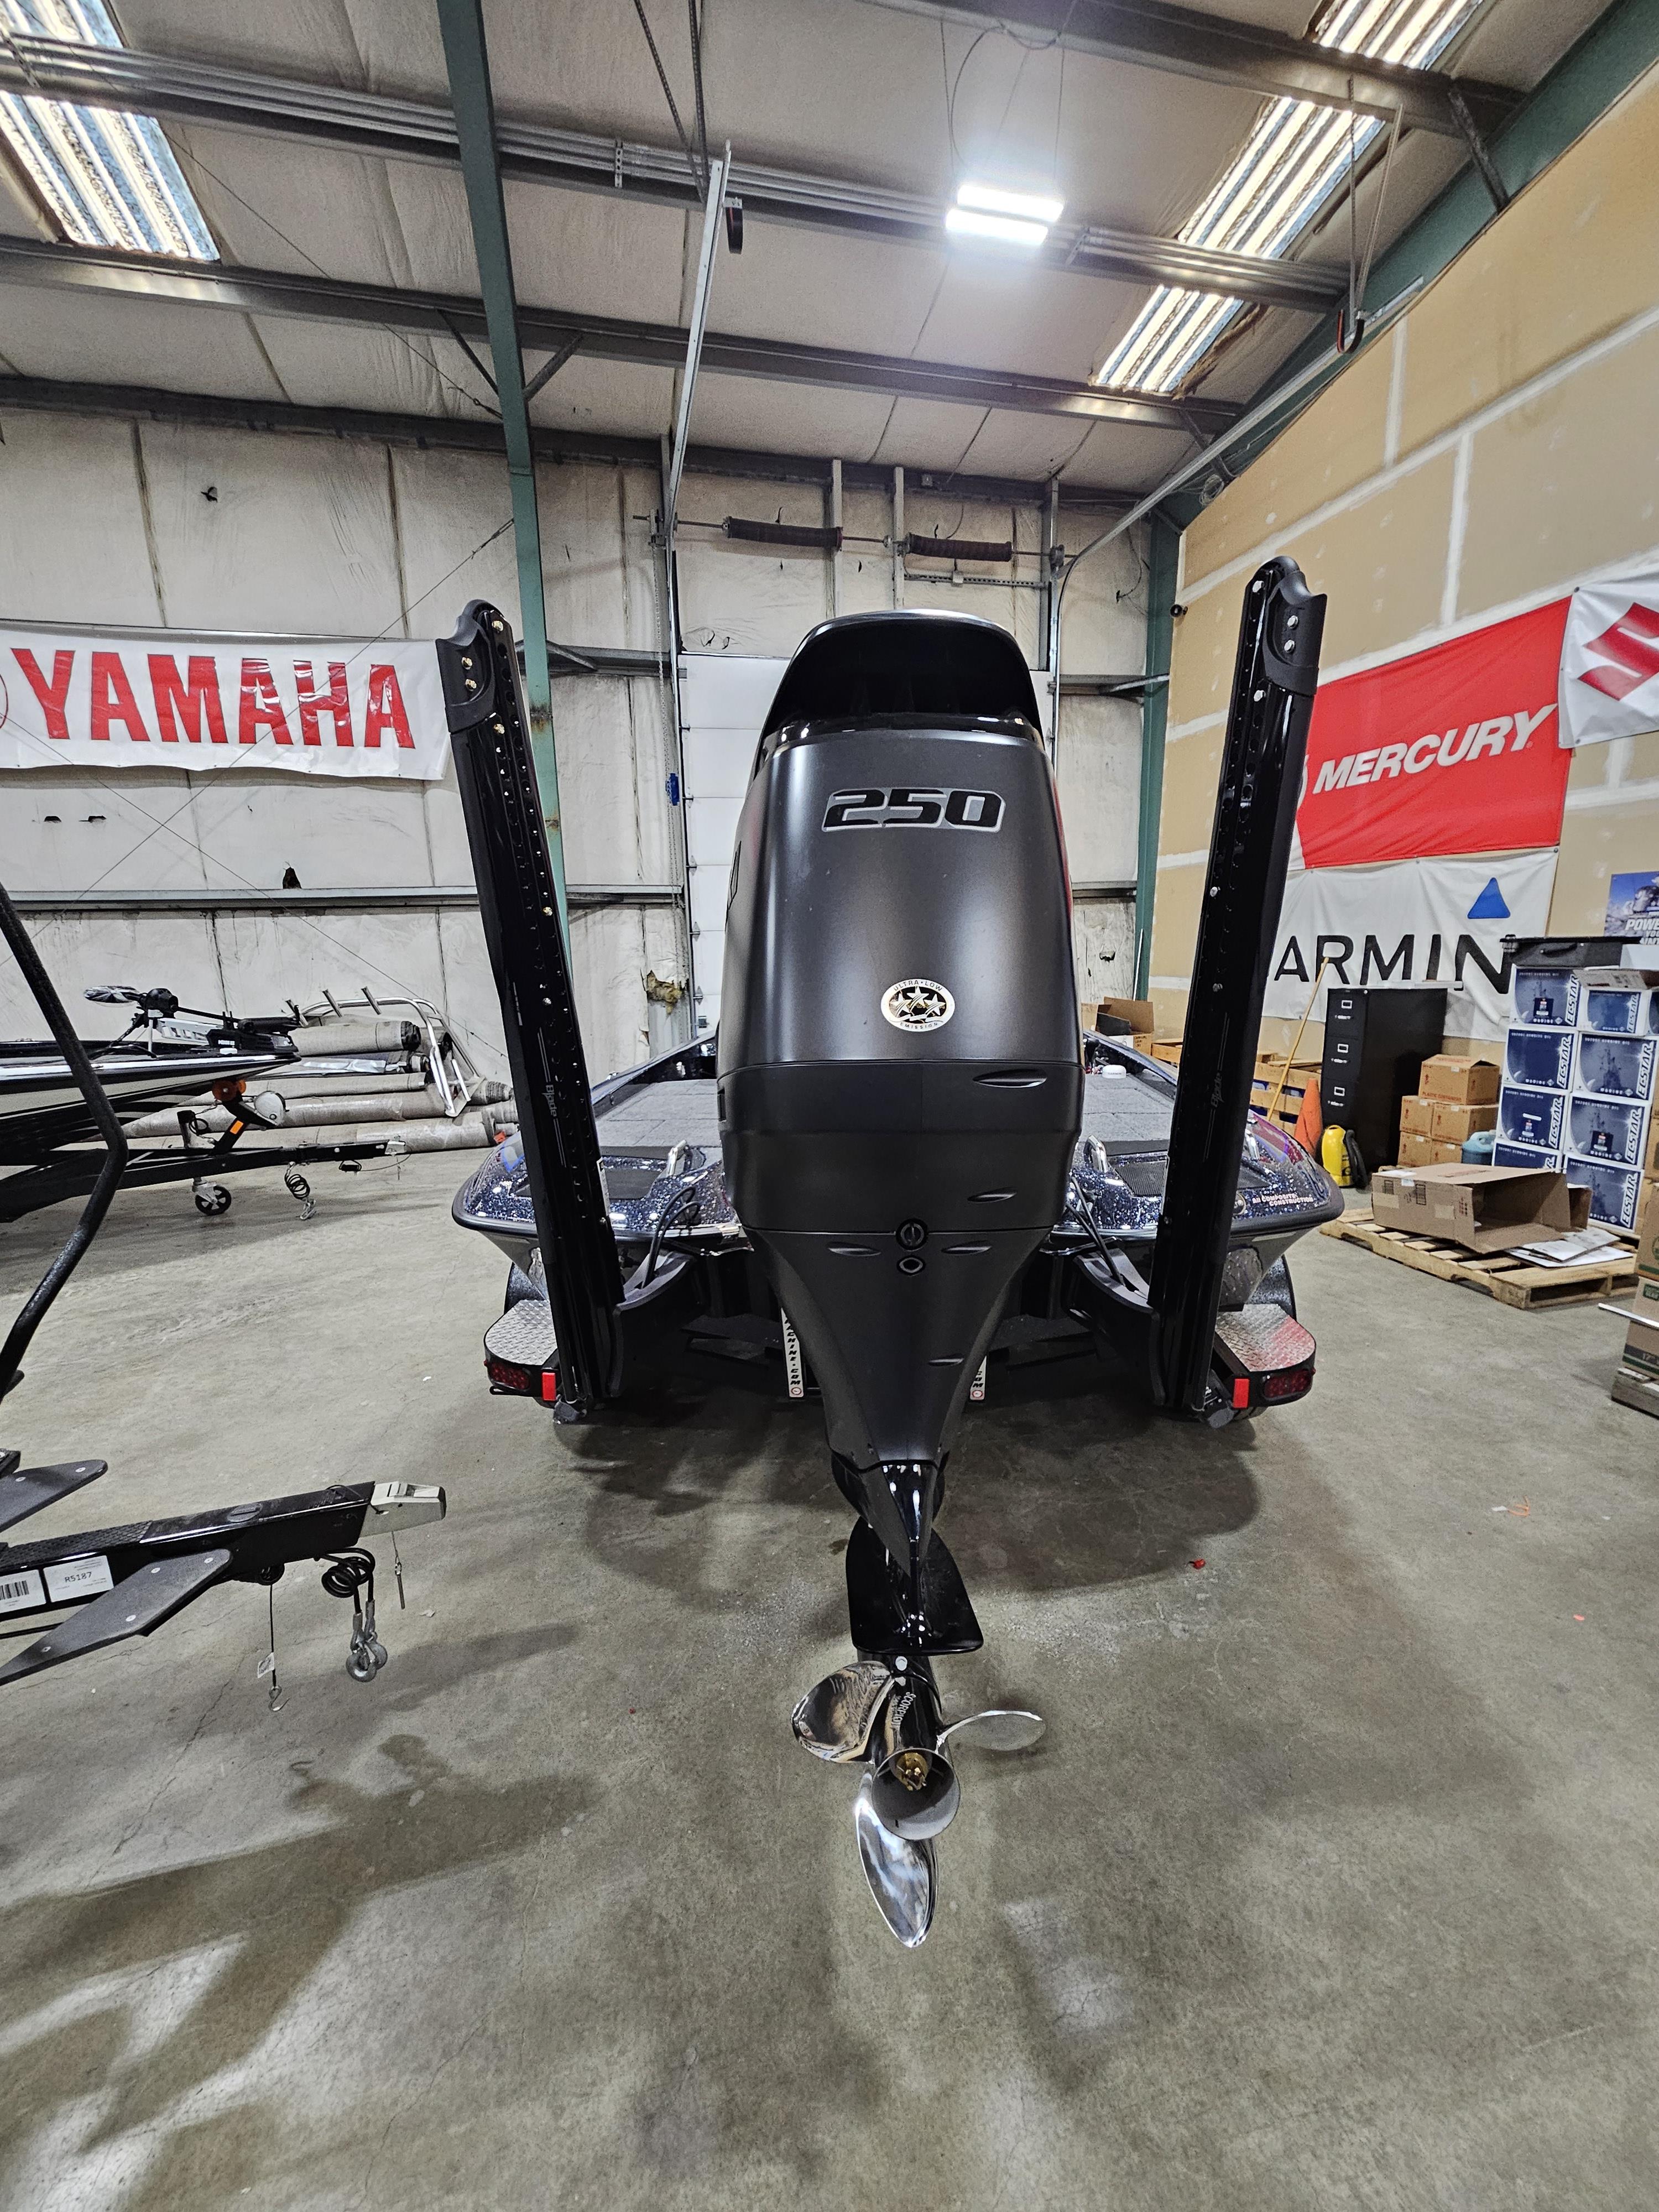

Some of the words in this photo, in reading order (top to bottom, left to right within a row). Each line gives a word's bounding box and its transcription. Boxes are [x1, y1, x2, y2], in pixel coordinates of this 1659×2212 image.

[11, 648, 416, 749] YAMAHA
[1312, 703, 1558, 795] MERCURY
[822, 787, 1005, 832] 250
[1625, 919, 1659, 930] POWE
[925, 980, 942, 991] LOW
[1274, 934, 1514, 994] ARMIN
[1558, 1037, 1571, 1088] ECSTAR
[1637, 1042, 1653, 1098] ECSTAR
[1626, 1109, 1641, 1163] ECSTAR
[1269, 1197, 1314, 1207] CONSTRUCTION
[1621, 1173, 1637, 1226] ECSTAR
[64, 1571, 92, 1583] R5187
